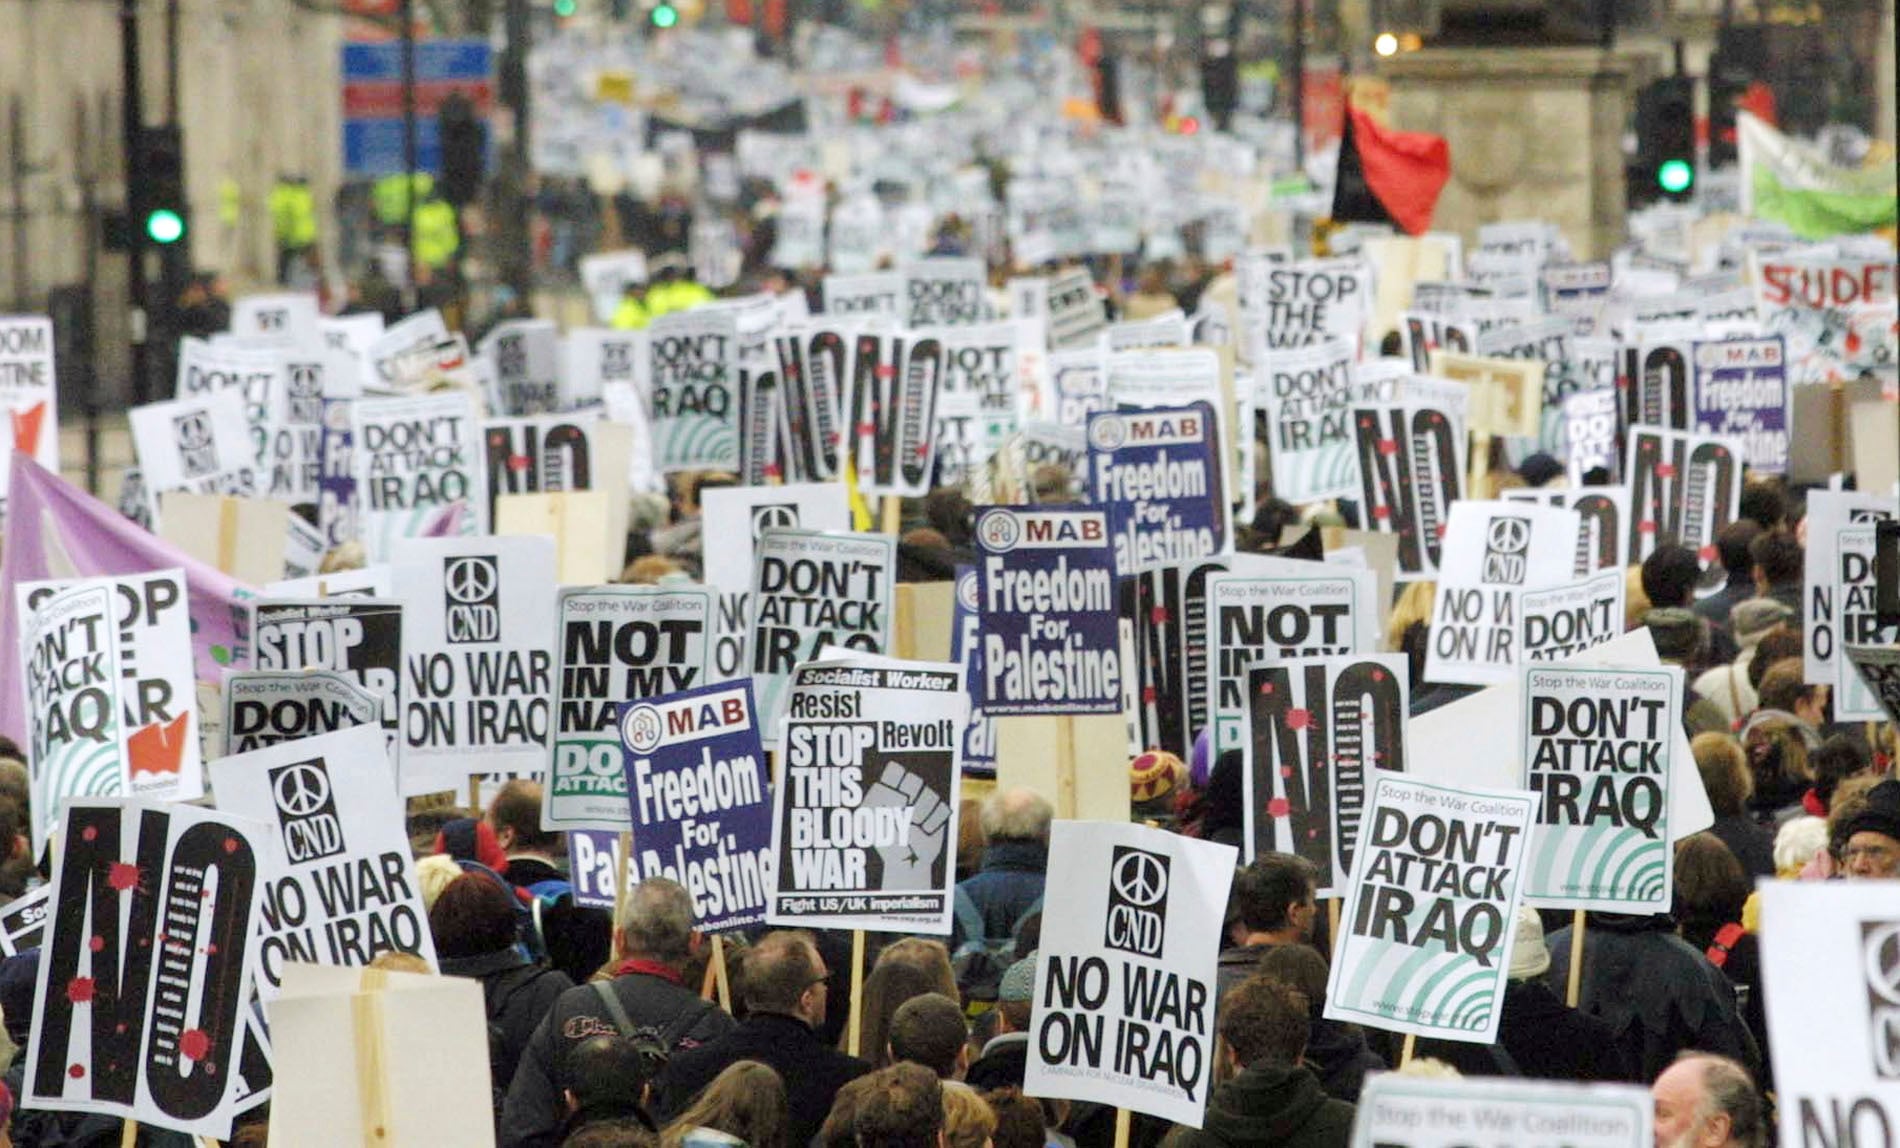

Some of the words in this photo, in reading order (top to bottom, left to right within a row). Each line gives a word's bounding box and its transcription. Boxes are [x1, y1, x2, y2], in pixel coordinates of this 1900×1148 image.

[1268, 269, 1357, 301] STOP
[1267, 300, 1327, 330] THE
[1274, 359, 1350, 398] DON'T
[849, 336, 941, 487] NO
[1131, 418, 1199, 440] MAB
[365, 415, 463, 450] DON'T
[368, 469, 469, 510] IRAQ
[1095, 450, 1206, 503] Freedom
[1355, 408, 1465, 573] NO
[1026, 519, 1103, 541] MAB
[1135, 501, 1170, 524] For
[1628, 434, 1736, 592] NO
[1113, 515, 1214, 576] alestine
[760, 557, 883, 600] DON'T
[985, 555, 1112, 613] Freedom
[1484, 554, 1526, 584] CND
[567, 599, 594, 613] Stop
[599, 600, 621, 611] the
[623, 601, 649, 612] War
[652, 601, 701, 613] Coalition
[1218, 586, 1247, 599] Stop
[1249, 585, 1269, 596] the
[1272, 585, 1296, 597] War
[1299, 584, 1348, 597] Coalition
[1441, 589, 1484, 623] NO
[447, 605, 498, 642] CND
[758, 596, 882, 632] ATTACK
[1029, 615, 1069, 640] For
[1219, 604, 1350, 646] NOT
[1524, 597, 1616, 649] DON'T
[258, 618, 364, 673] STOP
[564, 620, 703, 666] NOT
[755, 627, 878, 675] IRA
[1436, 627, 1478, 662] ON
[1485, 628, 1513, 664] IR
[408, 653, 454, 699] NO
[466, 651, 550, 697] WAR
[564, 668, 611, 699] IN
[626, 667, 700, 699] MY
[802, 668, 881, 686] Socialist
[886, 671, 952, 690] Worker
[984, 633, 1120, 701] Palestine
[1532, 675, 1562, 690] Stop
[1565, 676, 1587, 688] the
[1589, 676, 1612, 688] War
[1614, 677, 1665, 691] Coalition
[407, 702, 454, 747] ON
[467, 698, 548, 749] IRAQ
[560, 701, 622, 733] NA
[667, 698, 746, 737] MAB
[790, 690, 862, 718] Resist
[1531, 696, 1665, 740] DON'T
[790, 725, 875, 766] STOP
[883, 719, 954, 748] Revolt
[1249, 661, 1404, 889] NO
[1531, 738, 1663, 774] ATTACK
[552, 776, 627, 793] ATTAC
[634, 746, 762, 826] Freedom
[790, 767, 863, 808] THIS
[1380, 785, 1411, 800] Stop
[1414, 790, 1437, 806] the
[1439, 796, 1468, 811] War
[1470, 800, 1524, 817] Coalition
[1529, 772, 1663, 840] IRAQ
[284, 814, 342, 862] CND
[681, 821, 721, 850] For
[791, 806, 915, 849] BLOODY
[1371, 805, 1521, 867] DON'T
[791, 848, 867, 890] WAR
[1364, 849, 1512, 901] ATTACK
[257, 875, 308, 937] NO
[311, 851, 414, 919] WAR
[781, 898, 817, 914] Fight
[819, 898, 867, 913] US/UK
[869, 897, 940, 912] imperialism
[325, 904, 426, 967] IRAQ
[1107, 904, 1162, 955] CND
[1352, 883, 1503, 967] IRAQ
[32, 806, 257, 1121] NO
[1043, 955, 1110, 1011] NO
[1123, 961, 1208, 1036] WAR
[1038, 1011, 1105, 1068] ON
[1113, 1018, 1203, 1103] IRAQ
[1427, 1107, 1468, 1124] the
[1472, 1109, 1518, 1128] War
[1525, 1112, 1631, 1136] Coalition
